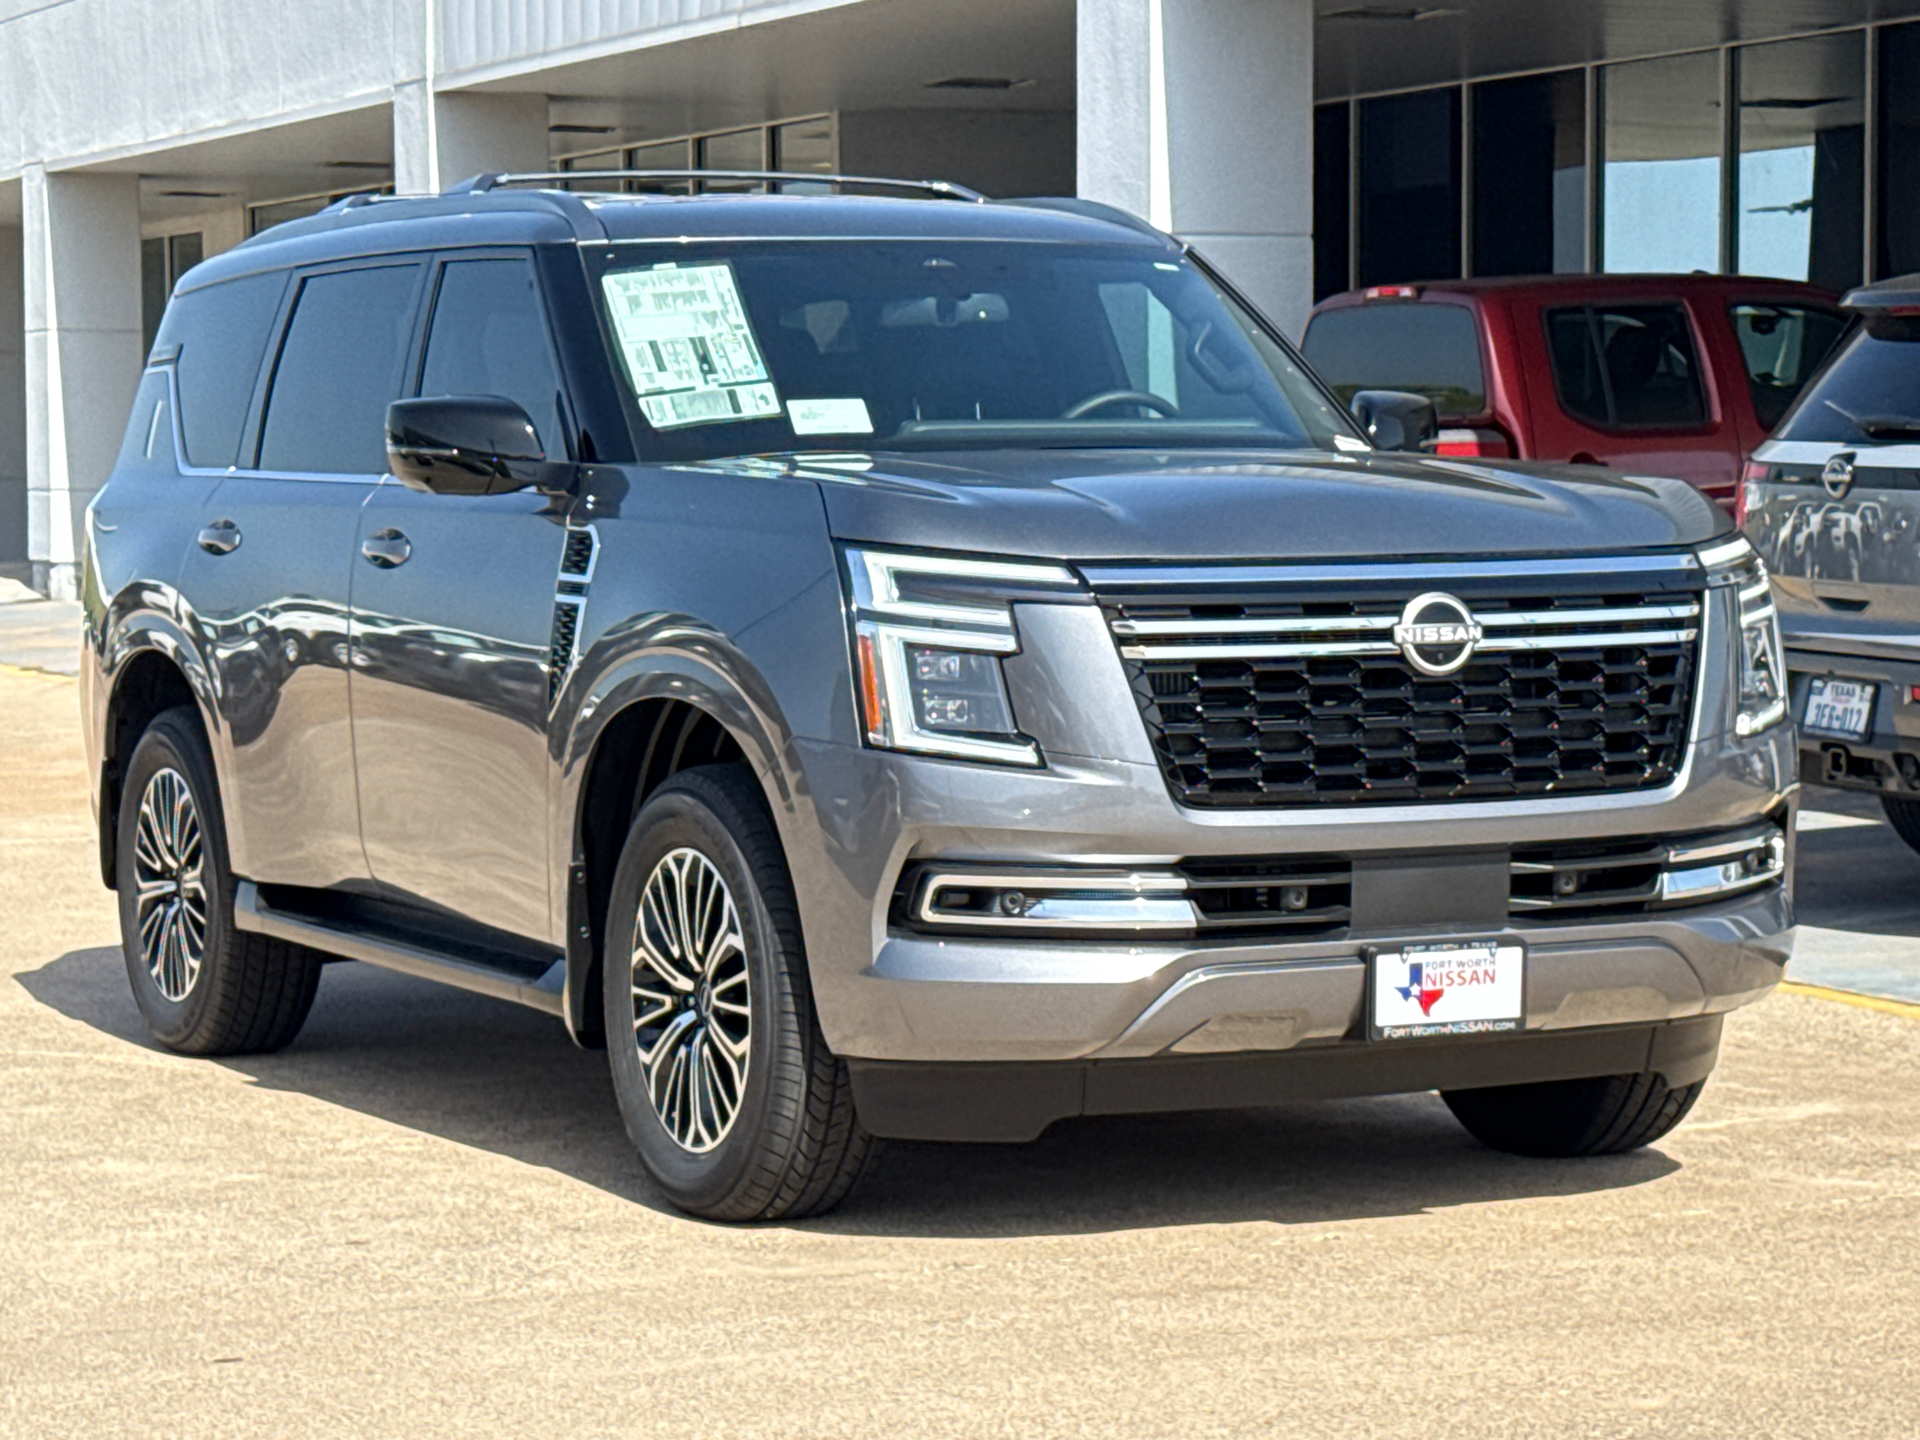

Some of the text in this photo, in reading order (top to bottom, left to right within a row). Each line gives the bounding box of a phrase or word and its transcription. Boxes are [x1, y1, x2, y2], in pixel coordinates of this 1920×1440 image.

[1397, 626, 1481, 642] NISSAN
[1831, 684, 1855, 697] TEXAS
[1425, 958, 1496, 970] FORT WORTH
[1425, 969, 1496, 987] NISSAN
